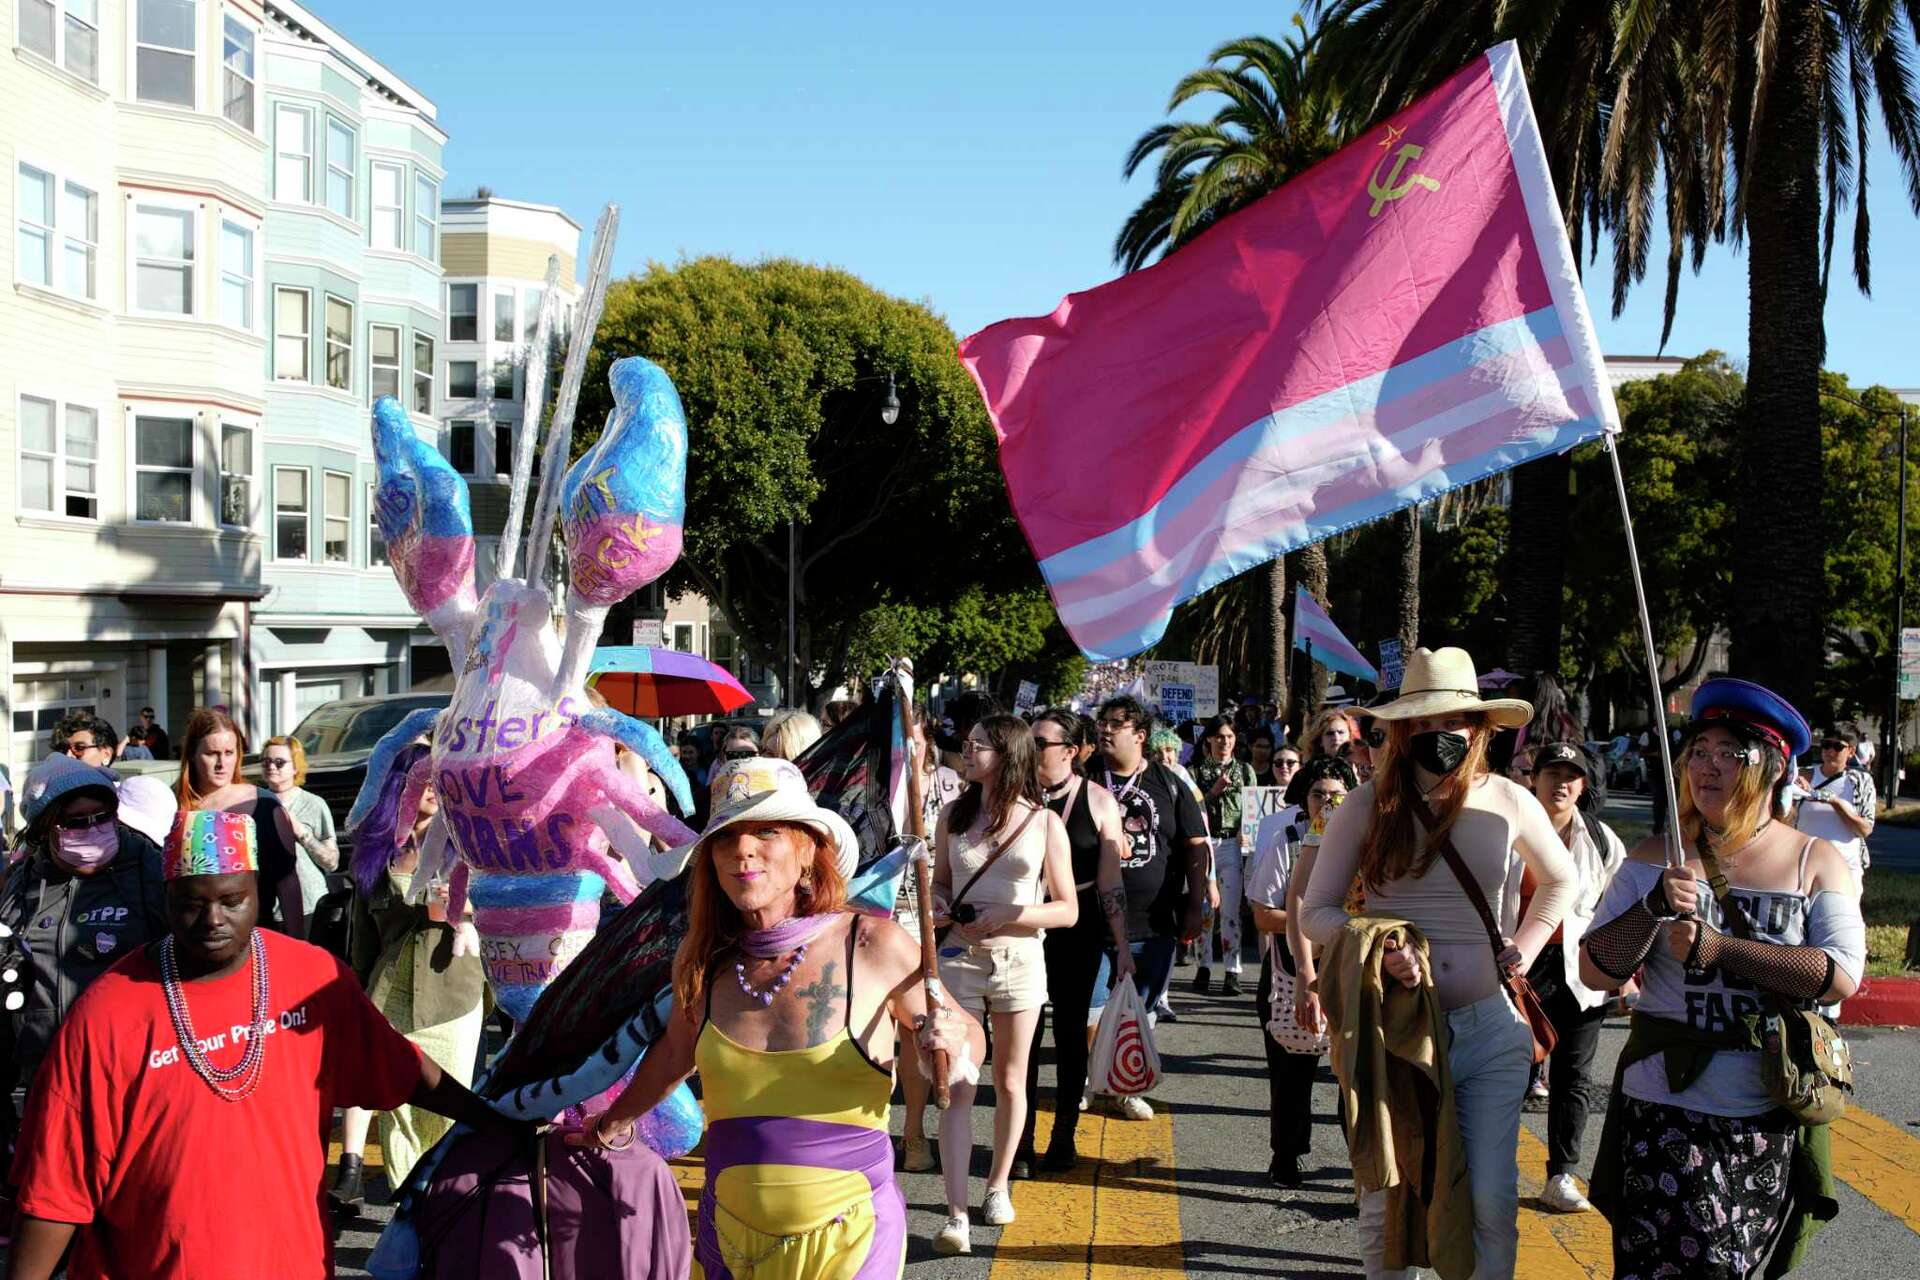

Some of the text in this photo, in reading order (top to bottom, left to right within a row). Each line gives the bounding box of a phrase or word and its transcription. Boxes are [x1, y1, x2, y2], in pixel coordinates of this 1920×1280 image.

[1162, 687, 1193, 700] DEFEND
[440, 696, 578, 752] sters
[438, 761, 525, 808] OVE
[451, 811, 575, 872] RANS
[149, 1006, 307, 1068] Get our Pre On!
